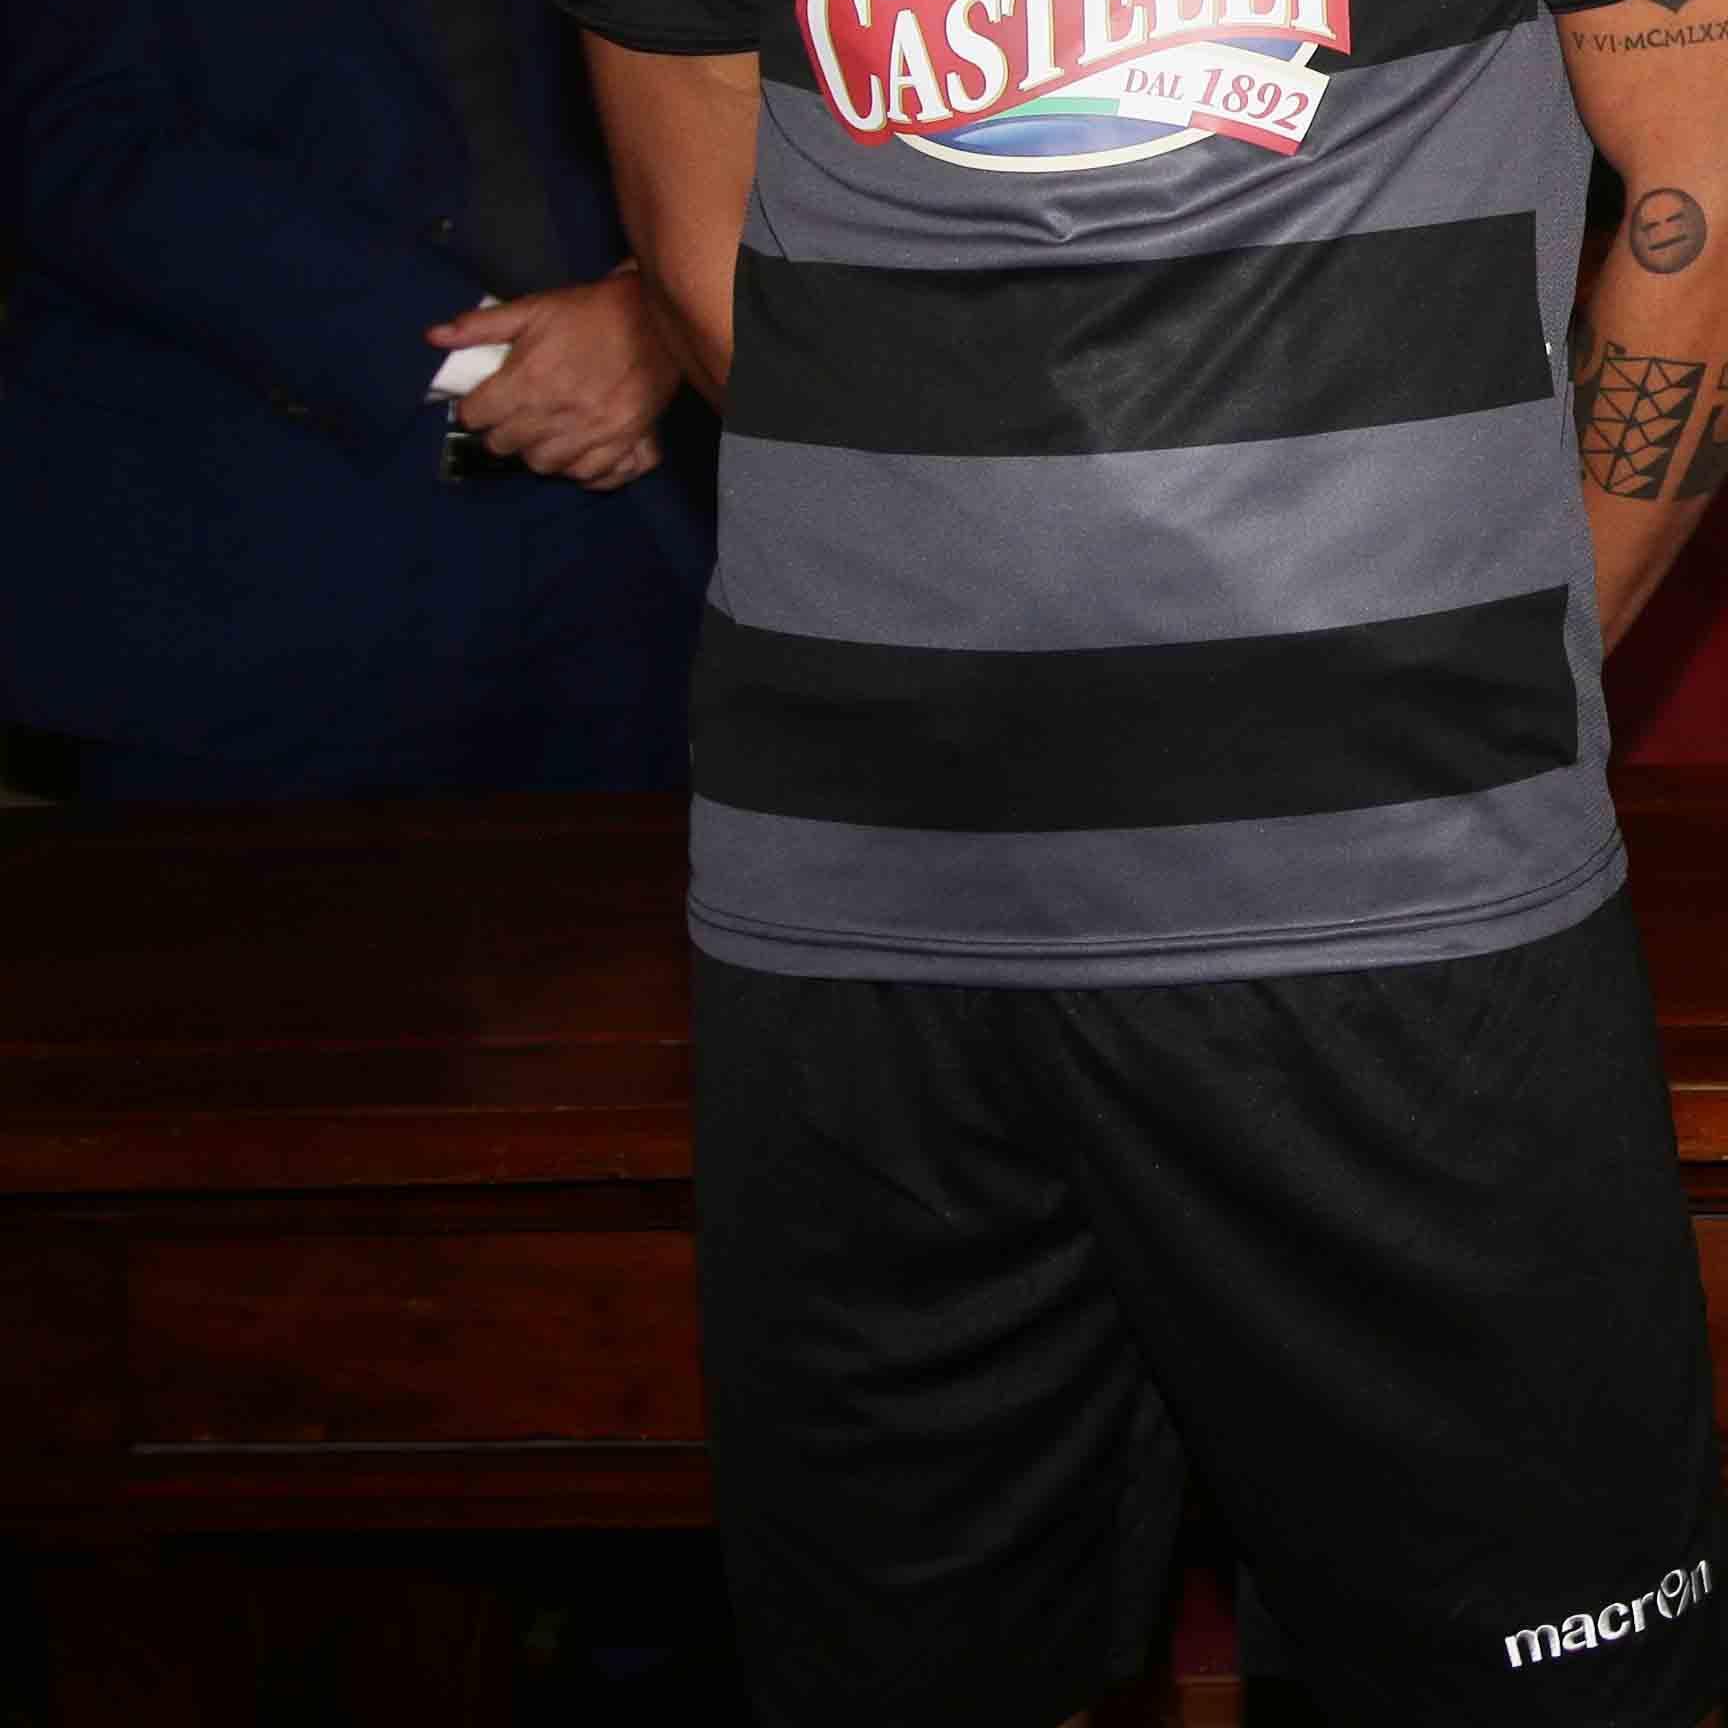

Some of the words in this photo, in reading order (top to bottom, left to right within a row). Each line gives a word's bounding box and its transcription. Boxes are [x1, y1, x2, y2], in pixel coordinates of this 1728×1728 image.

[1123, 67, 1185, 101] DAL
[1200, 67, 1310, 131] 1892
[1504, 1559, 1713, 1668] macron
